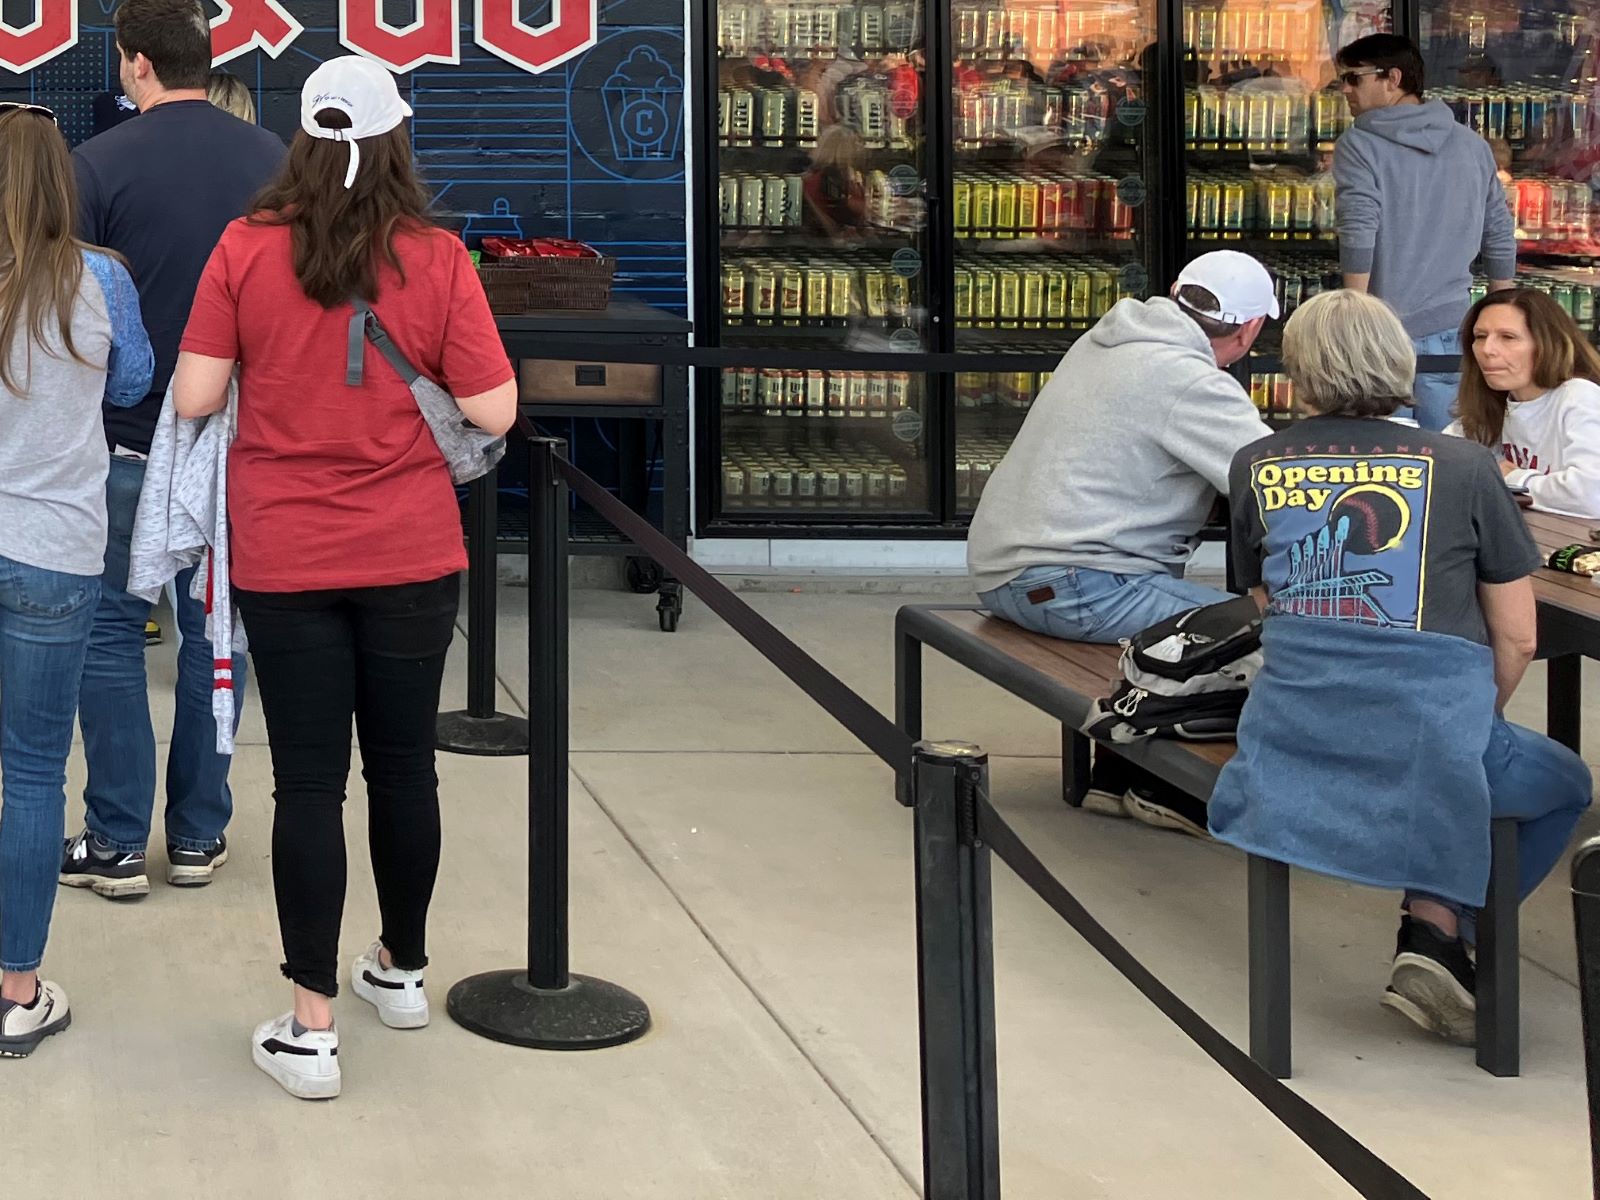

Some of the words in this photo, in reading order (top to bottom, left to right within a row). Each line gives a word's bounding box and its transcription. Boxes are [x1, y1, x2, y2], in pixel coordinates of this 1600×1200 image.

[1250, 444, 1434, 462] CLEVELAND
[1256, 461, 1424, 490] Opening
[1263, 486, 1332, 512] Day
